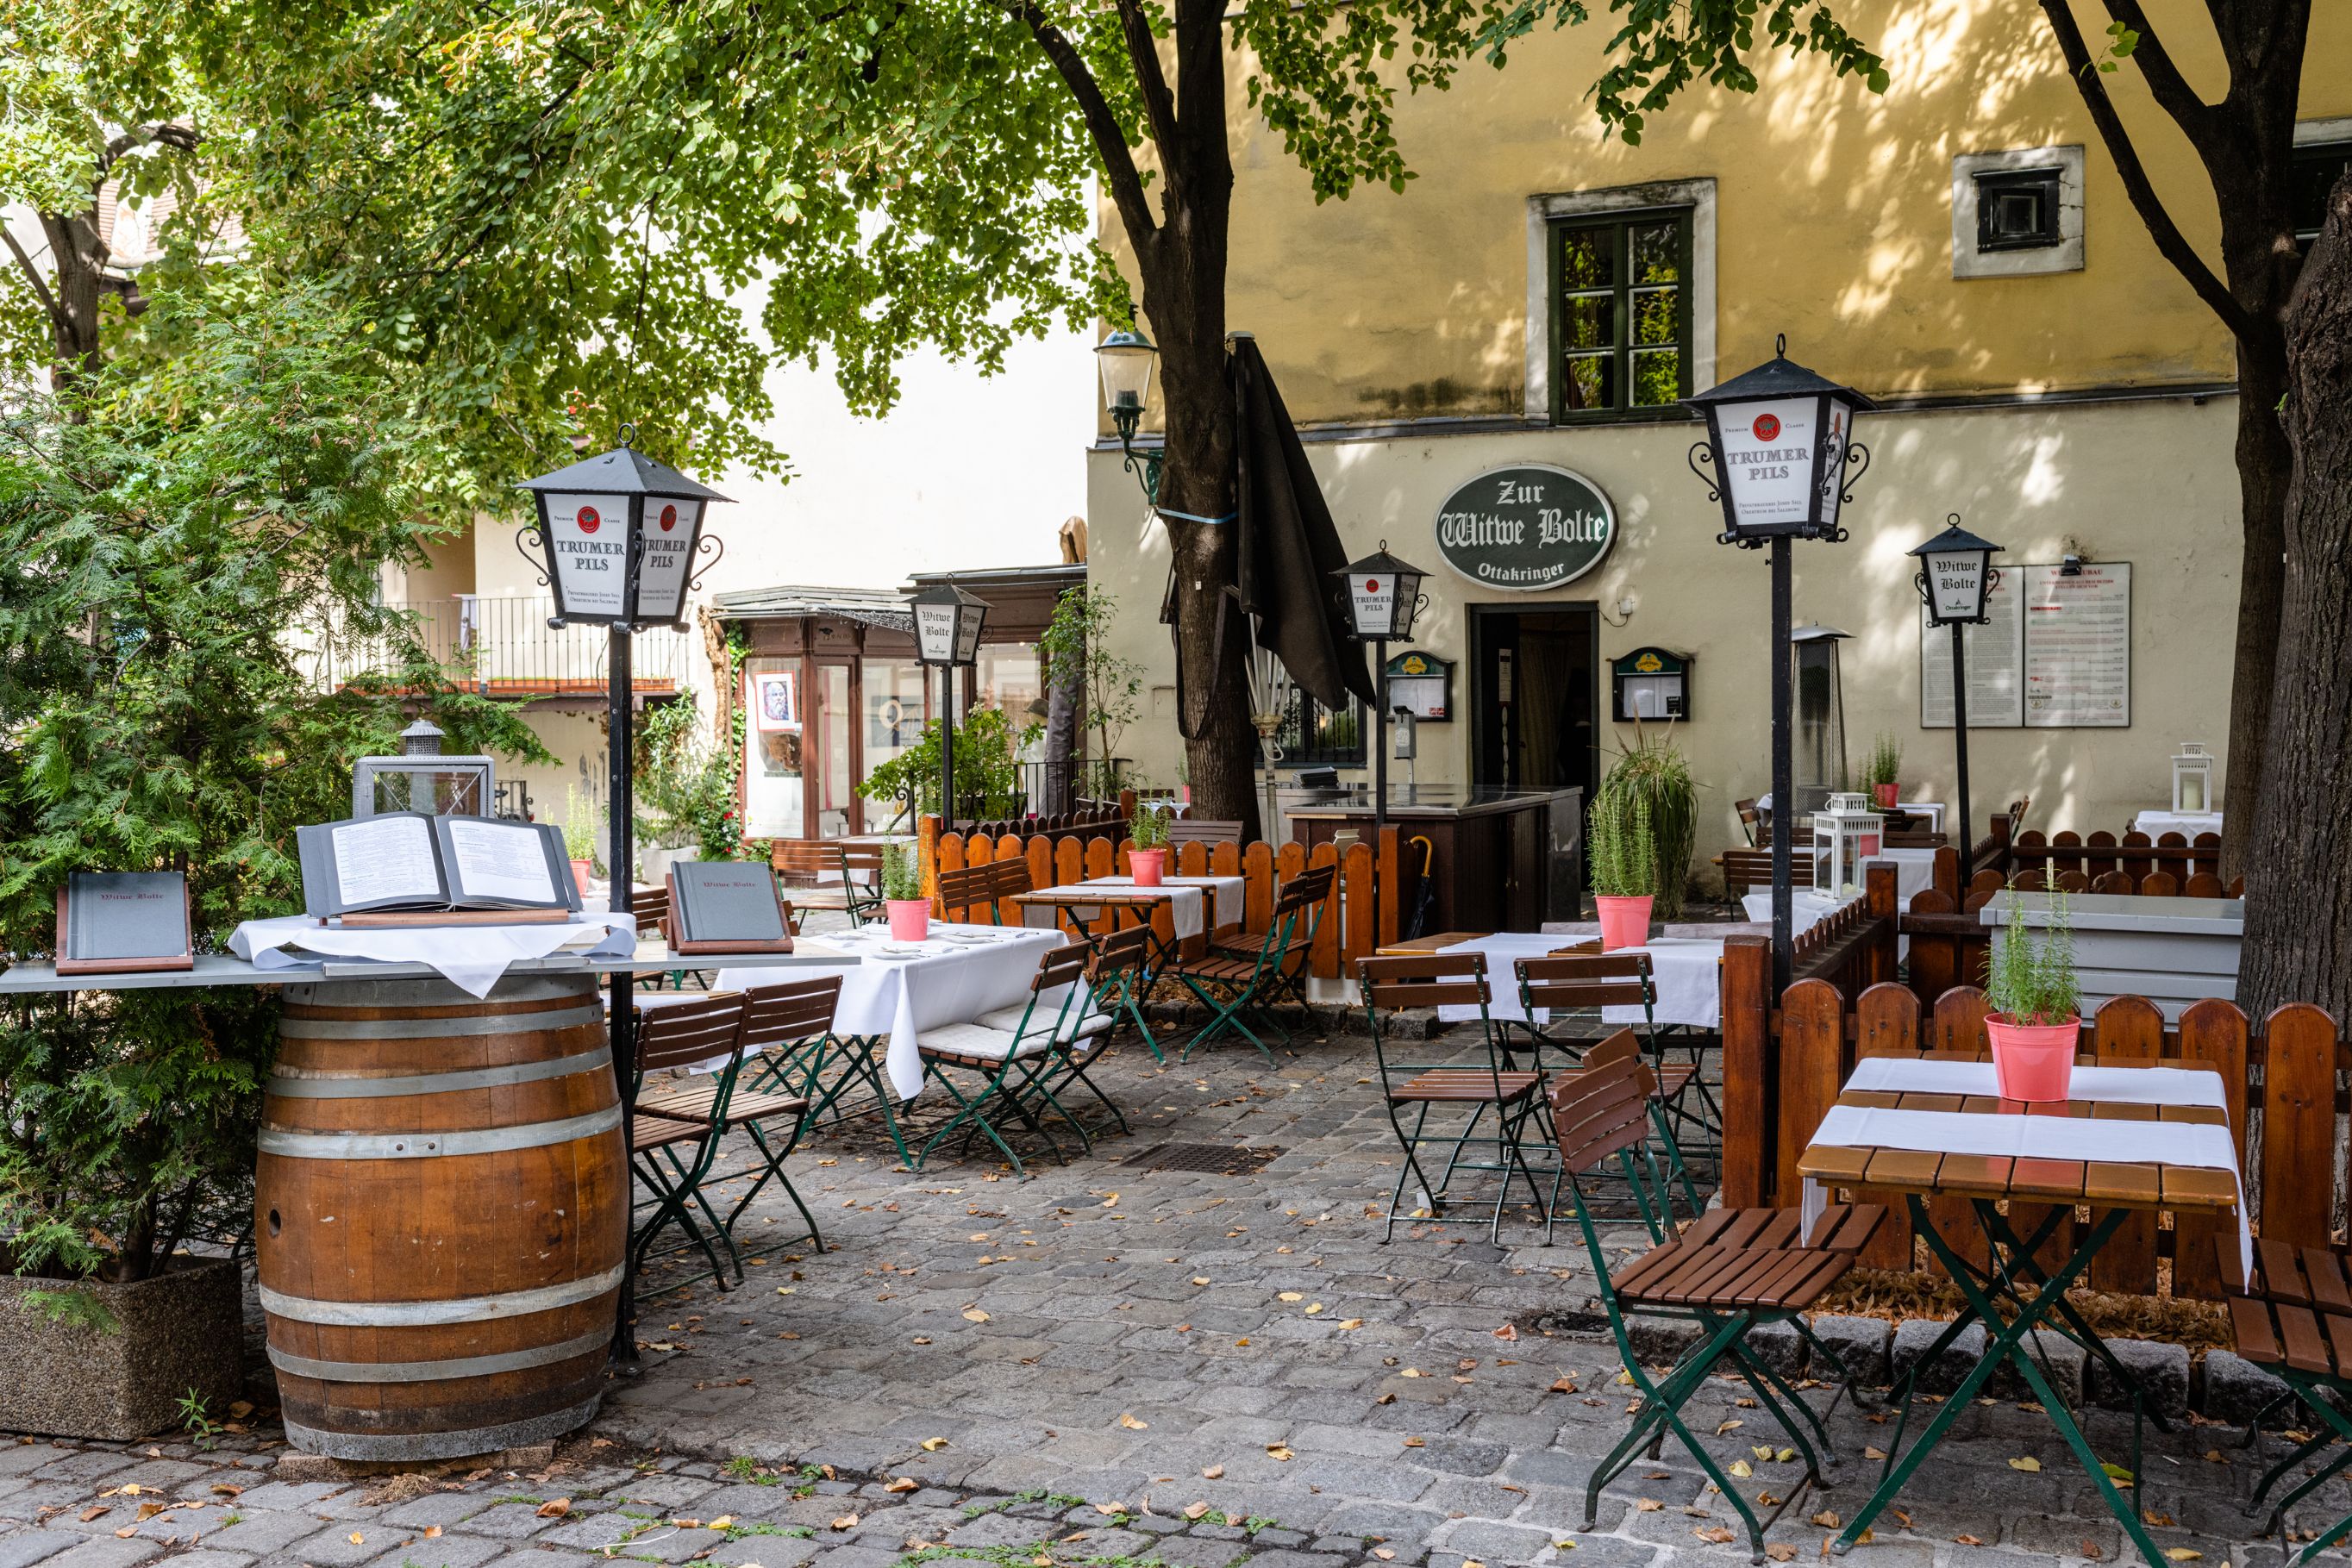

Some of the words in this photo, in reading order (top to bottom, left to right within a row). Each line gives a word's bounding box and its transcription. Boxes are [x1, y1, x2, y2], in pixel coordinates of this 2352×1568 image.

[1727, 448, 1810, 465] TRUMER
[1748, 465, 1789, 480] PILS
[1496, 480, 1544, 505] Zur
[1440, 512, 1525, 547] Witwe
[1538, 508, 1605, 549] Bolte
[556, 540, 625, 556] TRUMER
[574, 557, 609, 571] PILS
[650, 555, 674, 568] PILS
[1936, 561, 1977, 572] Witwe
[1478, 562, 1565, 581] Ottakringer
[1940, 578, 1976, 591] Bolte
[923, 610, 951, 622] Witwe
[925, 626, 949, 636] Bolte
